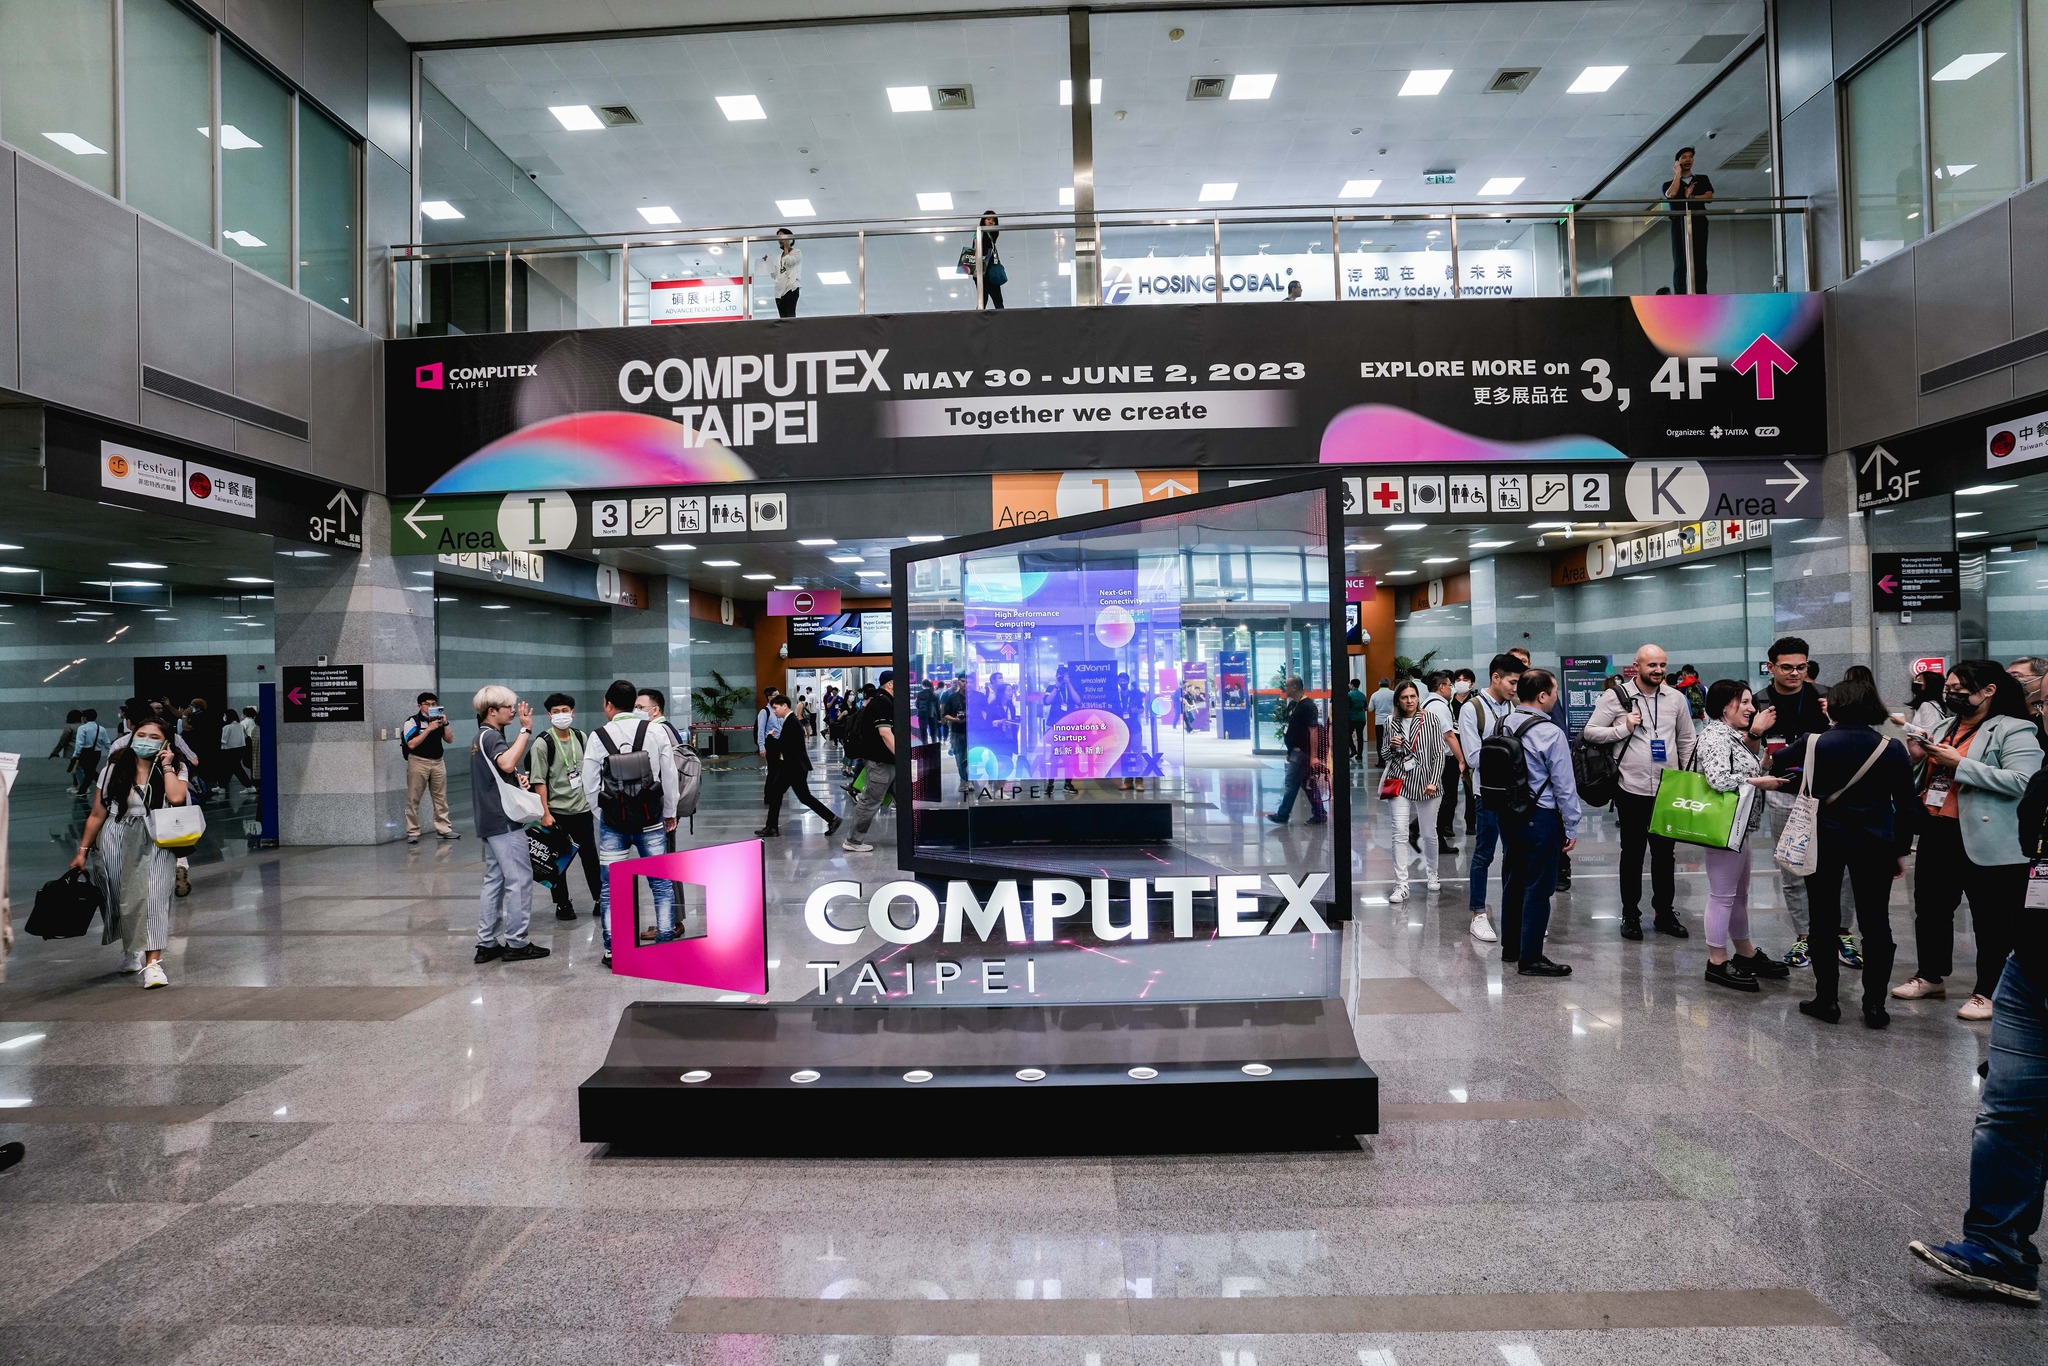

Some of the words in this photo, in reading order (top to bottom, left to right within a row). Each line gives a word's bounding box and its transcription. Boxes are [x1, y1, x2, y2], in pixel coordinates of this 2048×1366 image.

[1138, 273, 1285, 296] HOSINGLOBAL
[1348, 285, 1400, 298] Memory
[672, 290, 731, 306] 碩展科技
[665, 306, 710, 314] ADVANCETECH
[449, 364, 538, 380] COMPUTEX
[618, 348, 891, 404] COMPUTEX
[904, 370, 974, 390] MAY
[984, 368, 1031, 388] 30
[1062, 366, 1154, 385] JUNE
[1165, 364, 1198, 384] 2,
[1208, 362, 1306, 382] 2023
[1360, 361, 1464, 378] EXPLORE
[1472, 360, 1536, 376] MORE
[1544, 362, 1570, 375] on
[450, 381, 489, 390] TAIPEI
[1580, 358, 1630, 412] 3,
[1650, 356, 1718, 400] 4F
[1473, 386, 1568, 405] 更多展品在
[672, 400, 818, 449] TAIPEI
[945, 405, 1064, 430] Together
[1072, 407, 1112, 422] we
[1120, 402, 1208, 421] create
[1666, 428, 1705, 438] Organizers:
[2020, 442, 2044, 452] Taiwan
[138, 460, 176, 477] Festival
[214, 478, 254, 500] 中餐廳
[1582, 478, 1600, 502] 2
[1650, 467, 1686, 515] K
[1714, 493, 1776, 516] Area
[1888, 469, 1921, 502] 3F
[214, 494, 233, 504] Taiwan
[234, 500, 254, 508] Cuisine
[438, 527, 496, 550] Area
[528, 498, 546, 544] I
[602, 504, 618, 528] 3
[998, 506, 1049, 528] Area
[309, 516, 336, 542] 3F
[1666, 538, 1680, 548] ATM
[1562, 566, 1586, 582] Area
[1596, 545, 1604, 576] J
[622, 591, 638, 606] Area
[164, 662, 170, 670] 5
[1672, 797, 1712, 812] acer
[530, 846, 550, 861] TAIPEI
[804, 872, 1332, 945] COMPUTEX
[806, 958, 1037, 996] TAIPEI
